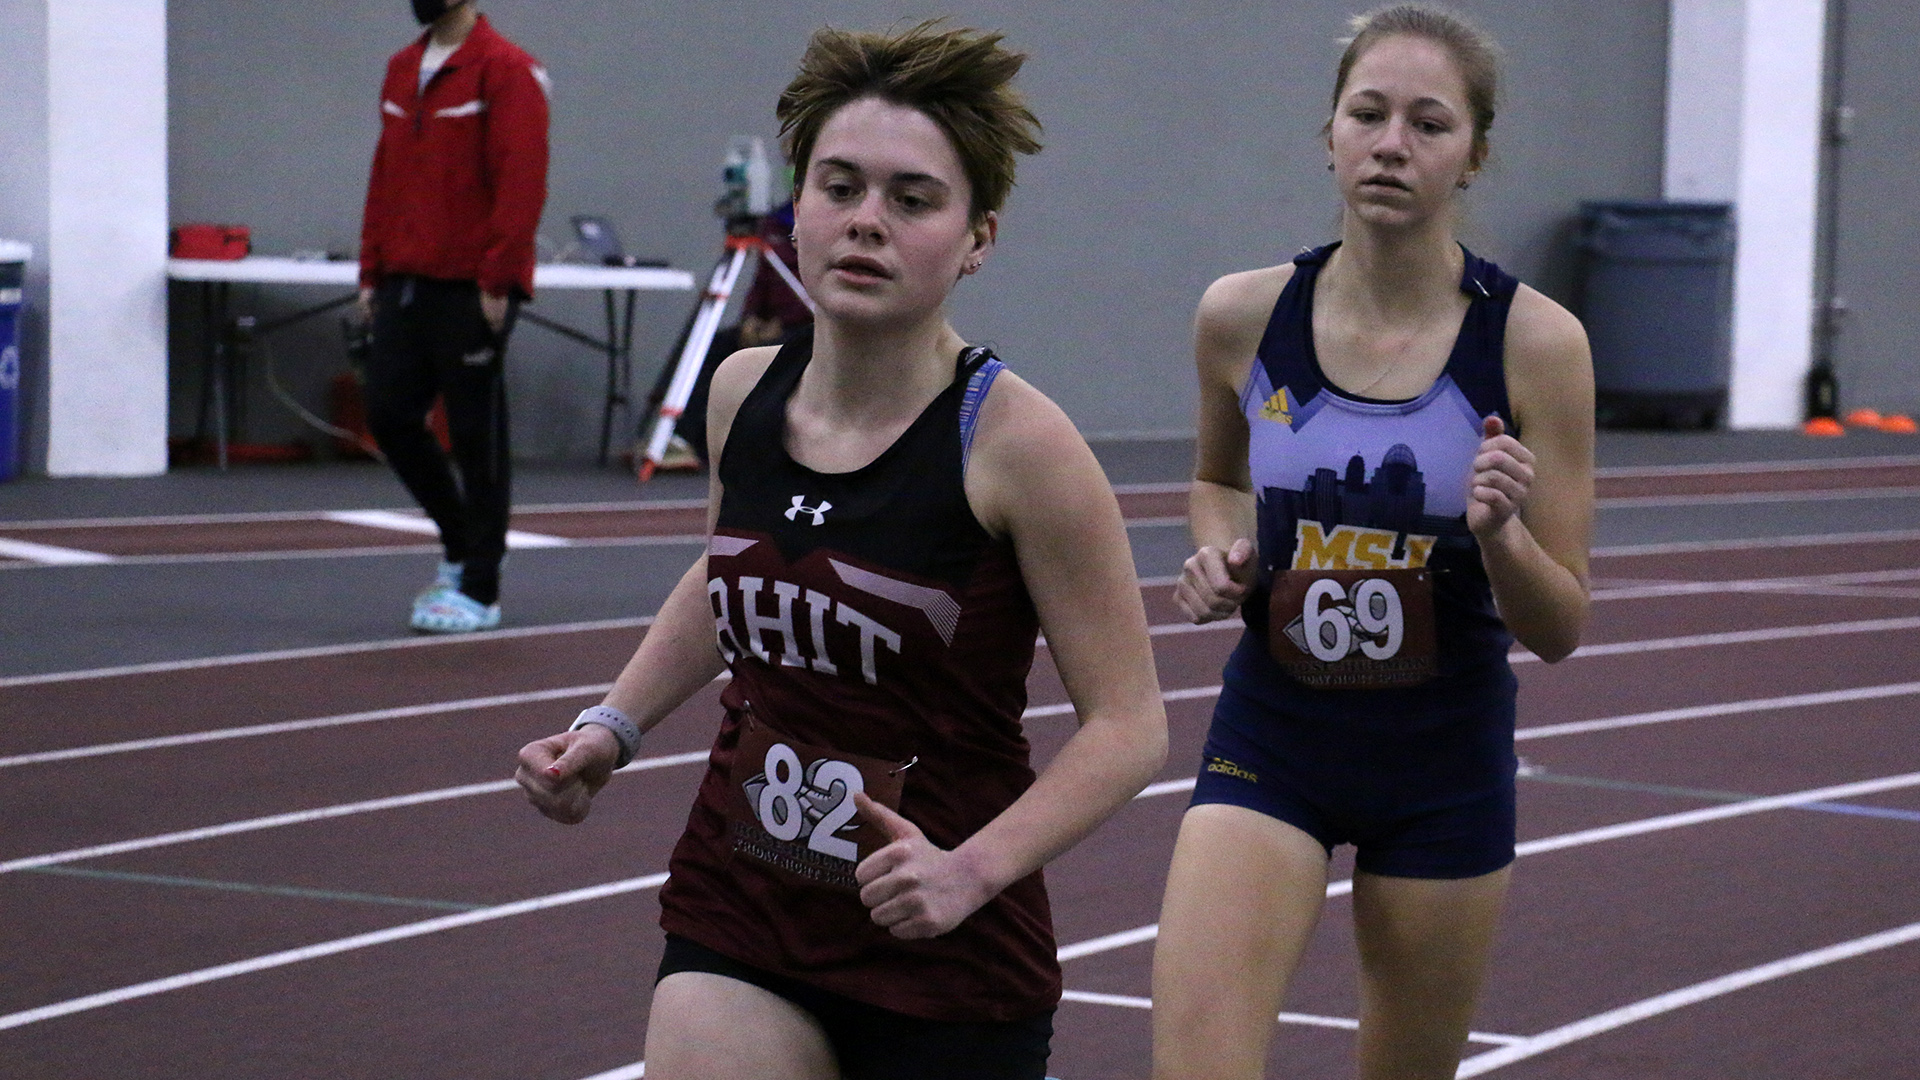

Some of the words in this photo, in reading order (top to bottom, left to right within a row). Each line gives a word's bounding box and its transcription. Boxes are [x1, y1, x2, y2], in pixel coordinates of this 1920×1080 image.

[708, 576, 901, 685] RHIT
[1303, 578, 1404, 662] 69
[759, 743, 864, 862] 82
[1207, 762, 1258, 784] adidas
